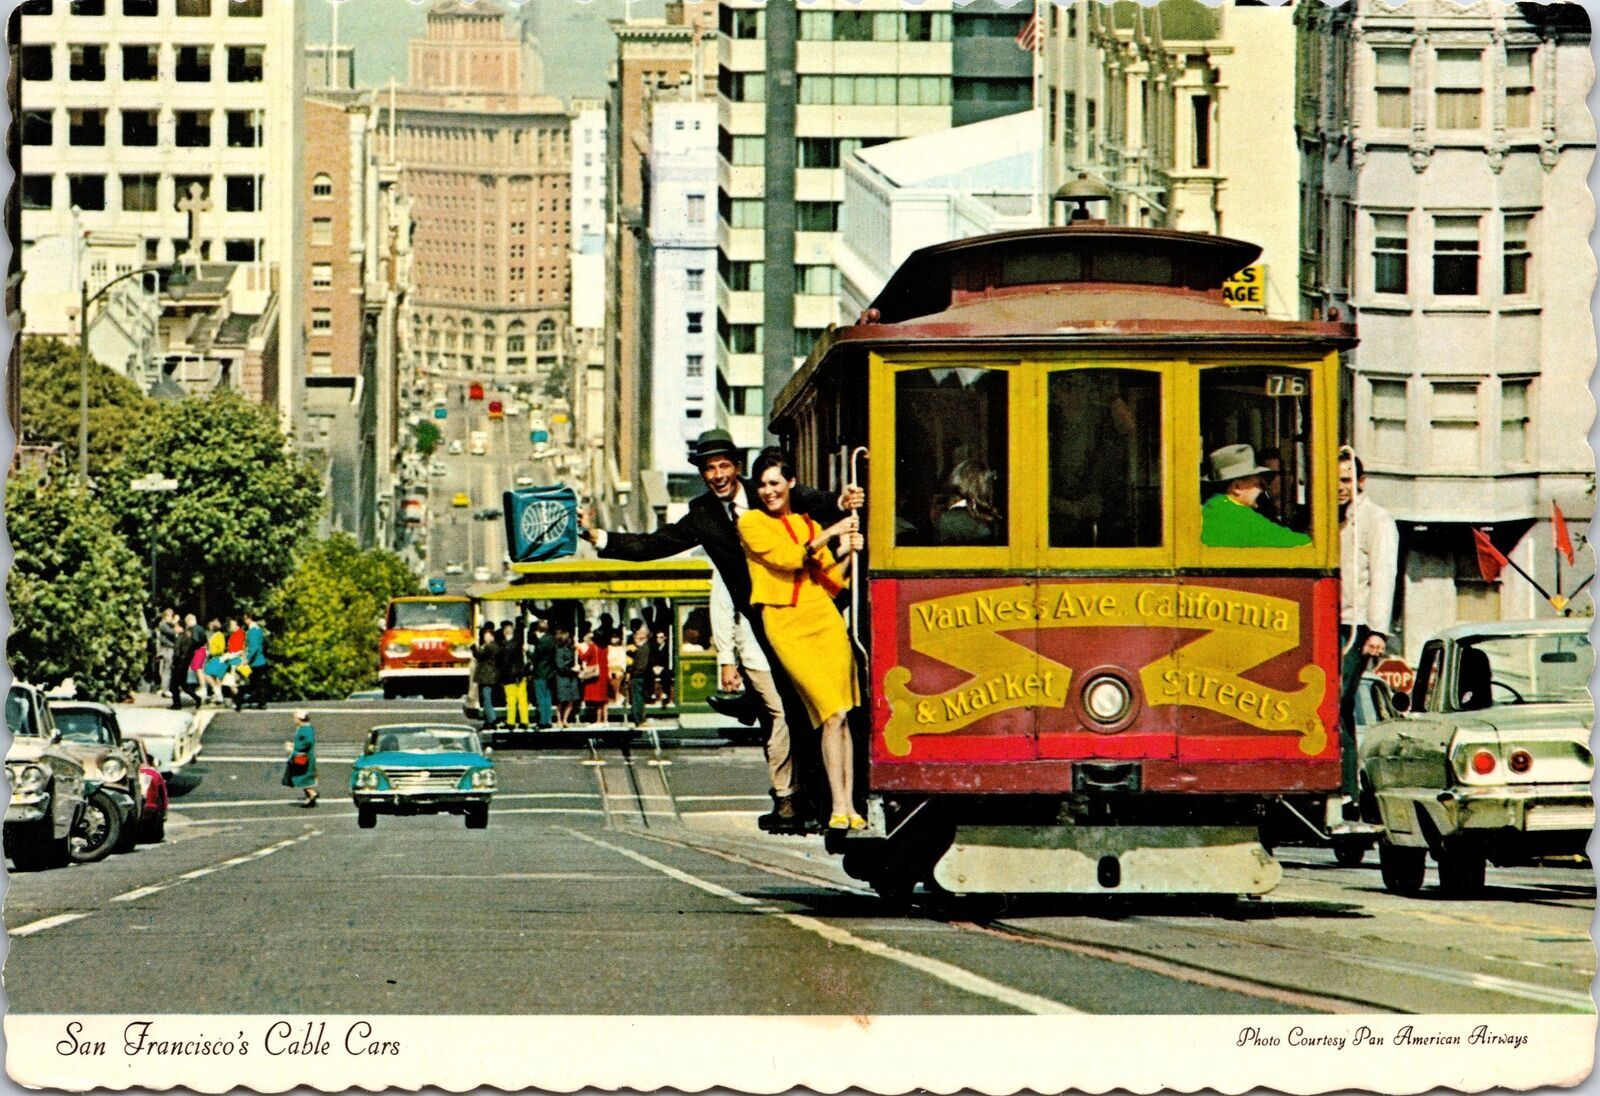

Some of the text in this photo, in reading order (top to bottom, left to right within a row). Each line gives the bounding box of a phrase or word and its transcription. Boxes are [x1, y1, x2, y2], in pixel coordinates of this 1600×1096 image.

[1271, 376, 1305, 395] 76
[917, 603, 972, 632] Van
[976, 596, 1049, 625] Ness
[1135, 589, 1290, 632] California
[915, 669, 1291, 725] & Market Streets
